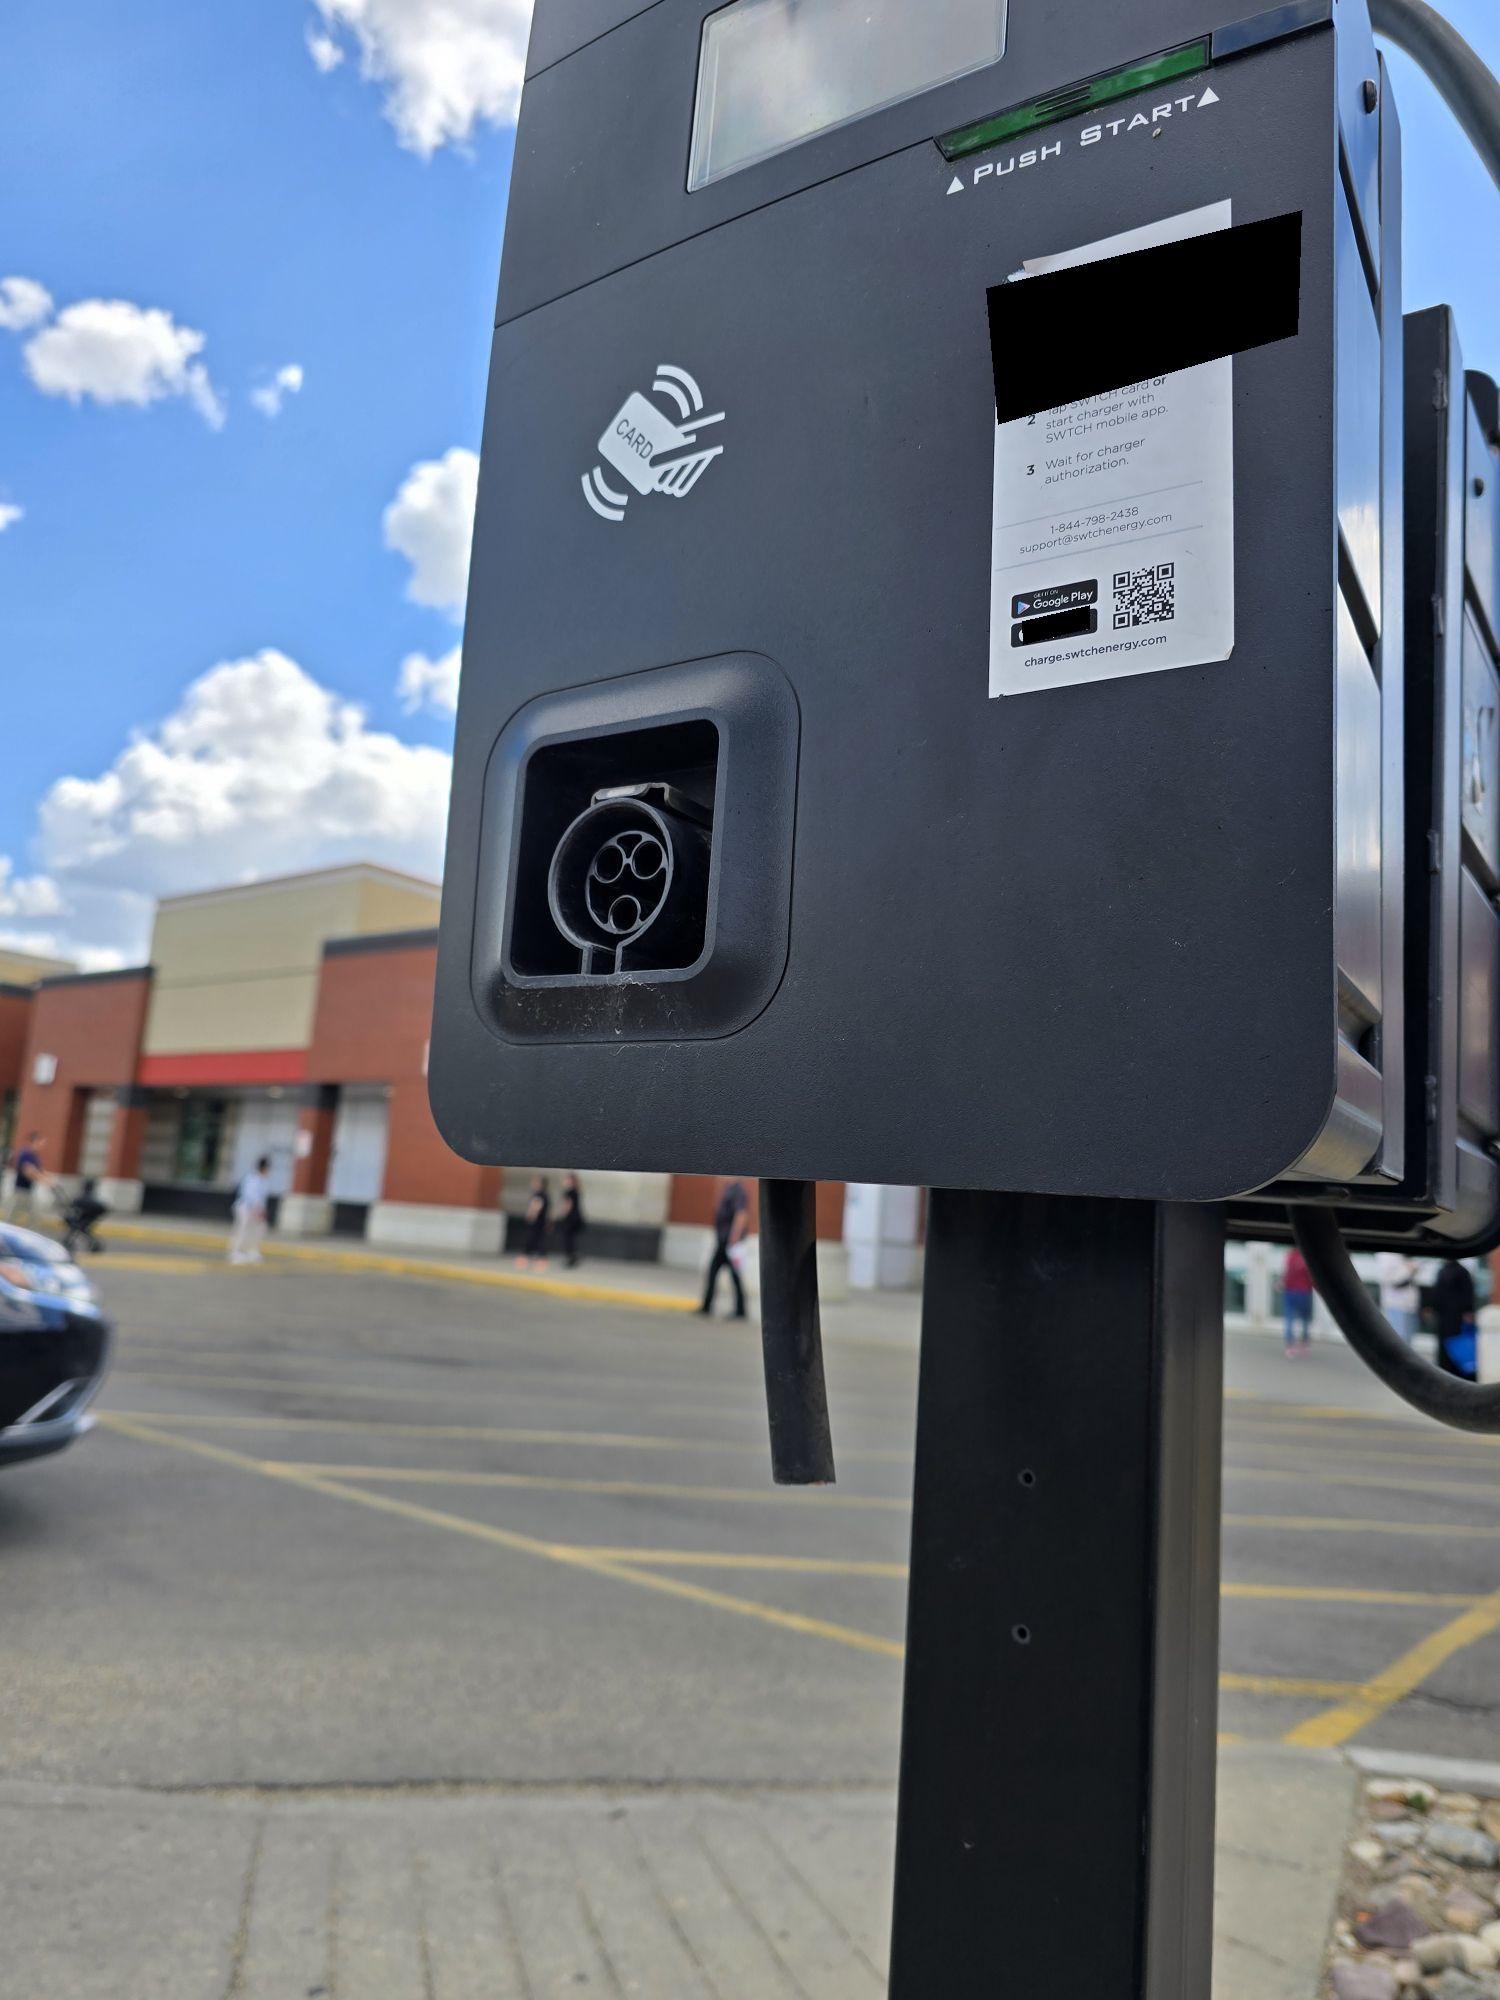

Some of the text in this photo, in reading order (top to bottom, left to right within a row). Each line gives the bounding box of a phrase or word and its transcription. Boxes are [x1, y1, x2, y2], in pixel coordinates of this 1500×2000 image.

[973, 94, 1195, 185] PUSH START
[1121, 380, 1149, 396] card
[1153, 376, 1167, 387] or
[1027, 415, 1036, 425] 2
[1045, 393, 1155, 430] start charger with
[1045, 405, 1169, 444] SWTCH mobile app.
[616, 418, 654, 460] CARD
[1045, 438, 1145, 470] Wait for charger
[1026, 464, 1036, 476] 3
[1044, 457, 1129, 485] authorization.
[1019, 513, 1172, 554] support@swtchenergy.com
[1050, 506, 1139, 534] 1-844-798-2438
[1033, 591, 1094, 609] Google Play
[1024, 634, 1167, 668] charge.swtchenergy.com
